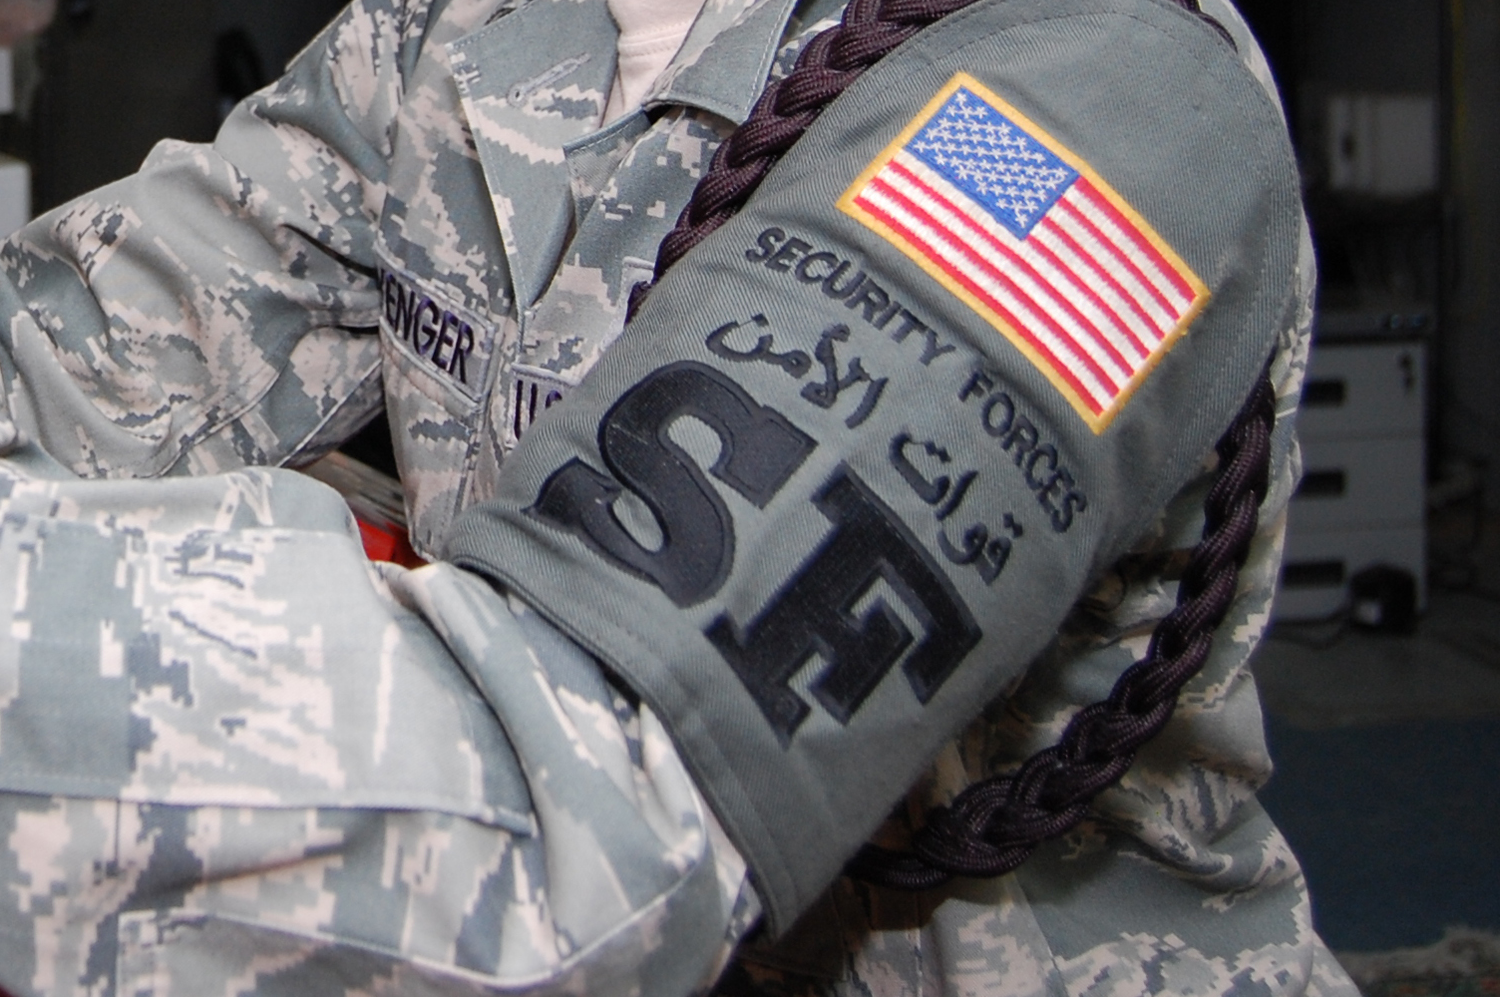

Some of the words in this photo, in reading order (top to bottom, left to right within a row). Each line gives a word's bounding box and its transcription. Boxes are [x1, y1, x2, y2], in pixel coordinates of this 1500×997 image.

[379, 270, 475, 385] ENGER
[745, 226, 957, 367] SECURITY
[958, 368, 1088, 534] FORCES
[518, 359, 984, 750] SF
[889, 432, 1024, 586] قوات
